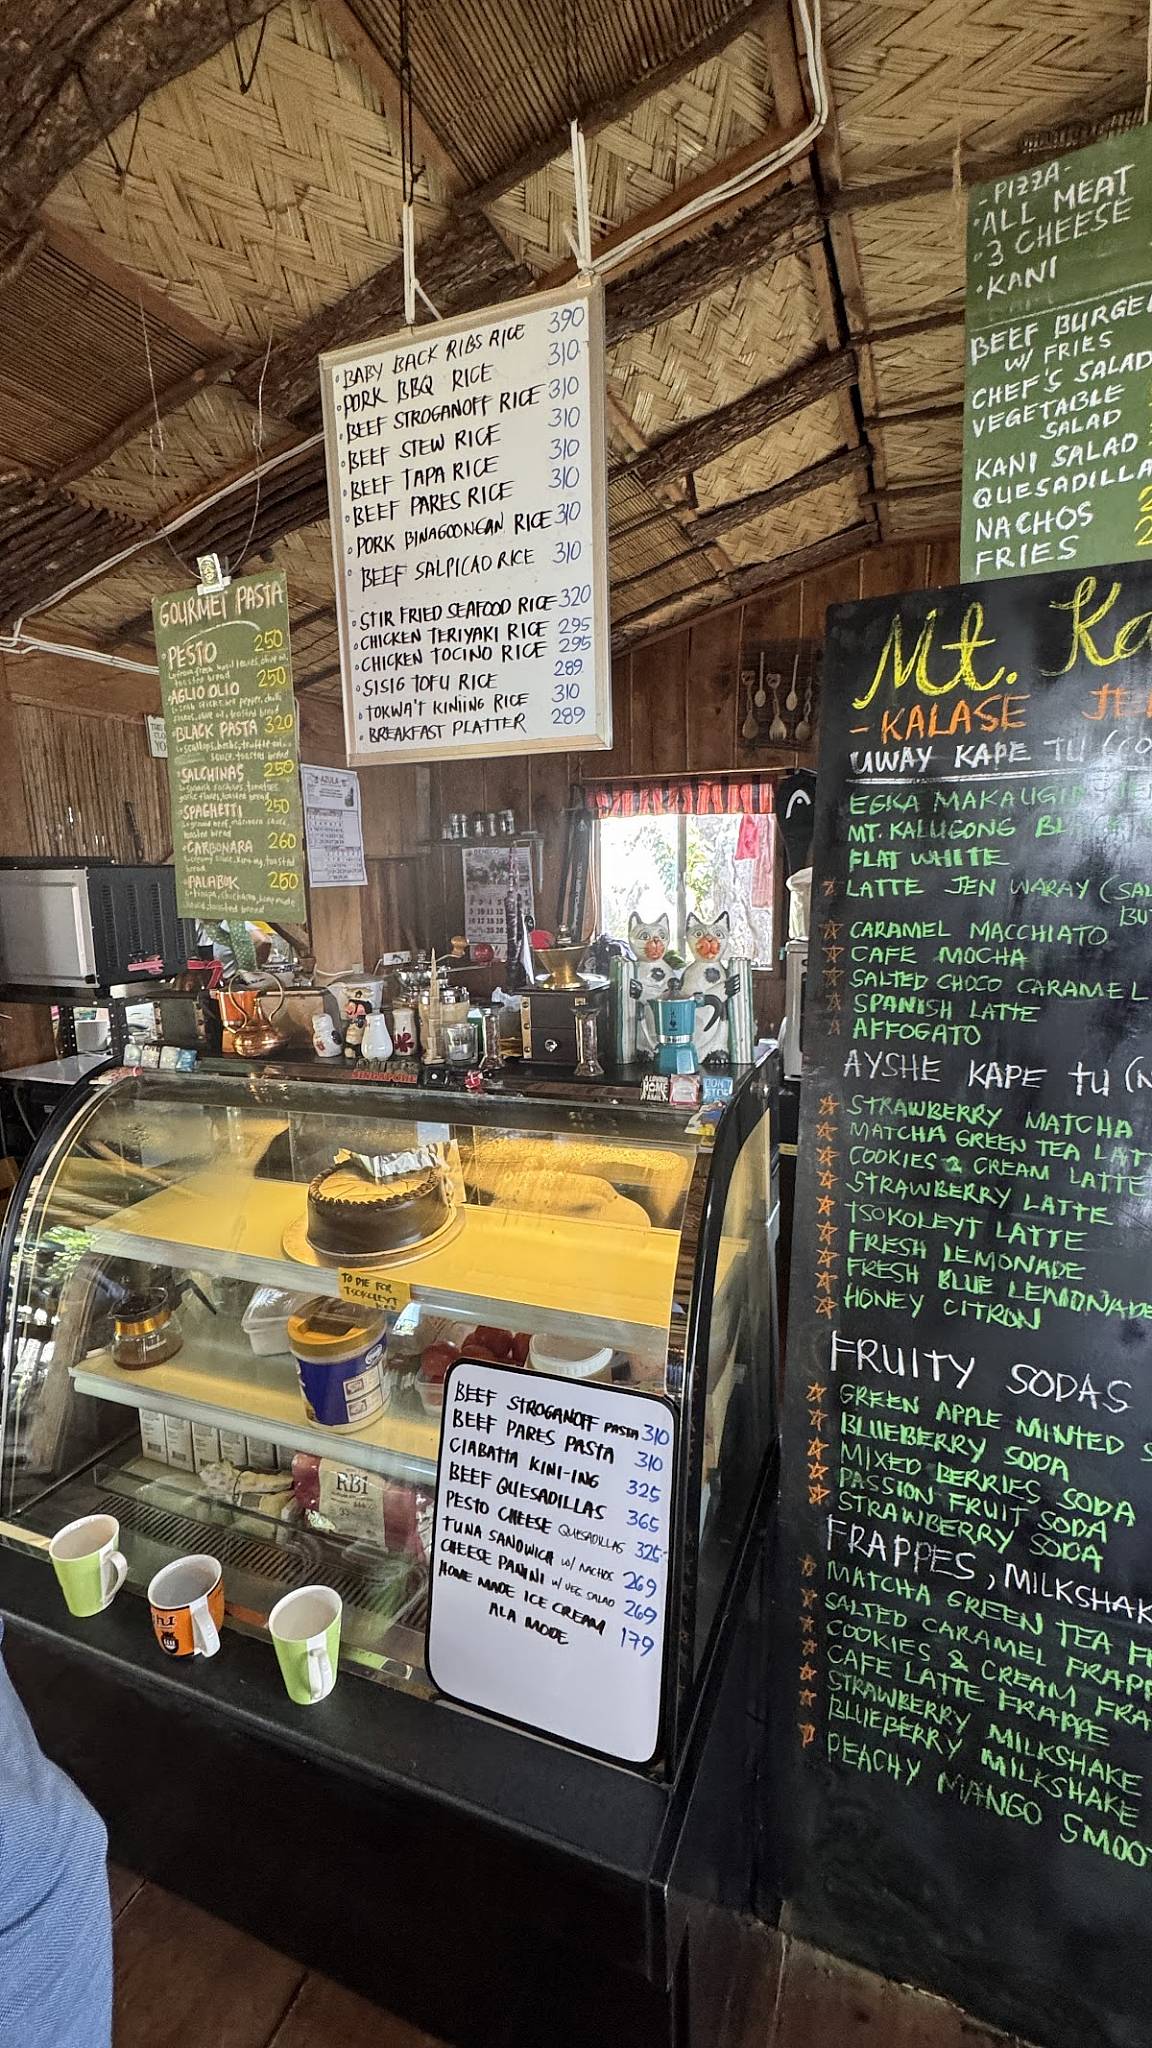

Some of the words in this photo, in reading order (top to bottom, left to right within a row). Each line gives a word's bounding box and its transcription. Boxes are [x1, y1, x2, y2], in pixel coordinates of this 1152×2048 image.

[982, 202, 1036, 236] ALL
[1054, 164, 1136, 213] MEAT
[987, 240, 1004, 267] 3
[1015, 197, 1134, 254] CHEESE
[986, 256, 1057, 300] KANI
[343, 363, 383, 390] BABY
[392, 344, 438, 374] BACK
[446, 333, 482, 362] RIBS
[489, 324, 525, 348] RICE
[547, 307, 584, 333] 390
[970, 322, 1038, 366] BEEF
[1044, 330, 1114, 364] FRIES
[344, 387, 388, 418] PORK
[397, 375, 434, 403] BBQ
[452, 363, 494, 392] RICE
[547, 340, 579, 366] 310
[973, 367, 1063, 410] CHEF'S
[973, 384, 1126, 438] VEGETABLE
[1040, 409, 1122, 440] SALAD
[975, 451, 1038, 481] KANI
[1051, 433, 1138, 468] SALAD
[975, 500, 1094, 542] NACHOS
[975, 535, 1079, 575] FRIES
[160, 591, 227, 627] GOURMET
[236, 581, 283, 614] PASTA
[360, 611, 393, 630] STIR
[400, 605, 442, 624] FRIED
[446, 599, 511, 619] SEAFOOD
[518, 595, 557, 614] RICE
[558, 585, 591, 608] 320
[168, 641, 217, 670] PESTO
[254, 630, 282, 651] 250
[361, 628, 422, 650] CHICKEN
[430, 625, 499, 645] TERIYAKI
[507, 620, 550, 639] RICE
[558, 617, 592, 634] 295
[851, 601, 1018, 710] Mt.
[171, 685, 204, 705] AGLIO
[209, 682, 239, 698] OLIO
[257, 666, 286, 688] 250
[176, 724, 214, 742] BLACK
[220, 720, 257, 739] PASTA
[264, 714, 292, 734] 320
[369, 724, 447, 743] BREAKFAST
[452, 713, 526, 737] PLATTER
[552, 707, 585, 725] 289
[181, 764, 244, 784] SALCHINAS
[263, 760, 294, 778] 250
[182, 804, 242, 820] SPAGHETTI
[265, 799, 289, 813] 250
[187, 840, 252, 853] CARBONARA
[267, 832, 296, 849] 260
[849, 850, 901, 872] FLAT
[912, 847, 1010, 867] WHITE
[187, 874, 240, 889] PALABOK
[850, 920, 951, 940] CARAMEL
[970, 921, 1108, 945] MACCHIATO
[851, 945, 917, 965] CAFE
[938, 947, 1030, 969] MOCHA
[850, 969, 928, 991] SALTED
[937, 974, 1002, 992] CHOCO
[1017, 978, 1149, 1001] CARAMEL
[853, 993, 952, 1020] SPANISH
[970, 1000, 1040, 1023] LATTE
[852, 1017, 981, 1046] AFFOGATO
[850, 1121, 947, 1144] MATCHA
[956, 1130, 1026, 1154] GREEN
[1036, 1139, 1080, 1161] TEA
[846, 1171, 1012, 1208] STRAWBERRY
[1023, 1194, 1114, 1226] LATTE
[342, 1272, 352, 1282] TO
[356, 1277, 369, 1287] DIE
[376, 1282, 392, 1293] FOR
[847, 1258, 918, 1285] FRESH
[938, 1269, 993, 1295] BLUE
[830, 1330, 975, 1389] FRUITY
[1006, 1364, 1133, 1413] SODAS
[455, 1381, 498, 1407] BEEF
[507, 1395, 600, 1432] STROGANOFF
[604, 1422, 639, 1440] PASTA
[641, 1424, 670, 1445] 310
[453, 1409, 498, 1433] BEEF
[506, 1419, 555, 1446] PARES
[564, 1435, 614, 1465] PASTA
[634, 1451, 663, 1471] 310
[449, 1462, 492, 1488] BEEF
[496, 1477, 607, 1520] QUESADILLAS
[627, 1510, 659, 1532] 365
[529, 1455, 599, 1488] KINI-ING
[626, 1480, 661, 1502] 325
[840, 1441, 921, 1475] MIXED
[936, 1462, 1041, 1504] BERRIES
[1056, 1487, 1136, 1527] SODA
[447, 1490, 489, 1515] PESTO
[498, 1507, 553, 1534] CHEESE
[558, 1524, 626, 1554] QUESADILLAS
[839, 1467, 934, 1505] PASSION
[949, 1492, 1030, 1527] FRUIT
[1037, 1511, 1107, 1544] SODA
[442, 1516, 482, 1538] TUNA
[579, 1564, 614, 1582] NACHOS
[623, 1571, 657, 1597] 269
[441, 1538, 493, 1565] CHEESE
[498, 1555, 545, 1585] PANINI
[587, 1591, 615, 1608] SALAD
[624, 1600, 657, 1625] 269
[477, 1576, 515, 1599] MADE
[524, 1591, 548, 1609] ICE
[552, 1602, 606, 1635] CREAM
[620, 1627, 654, 1657] 179
[489, 1602, 517, 1623] ALA
[525, 1616, 569, 1646] MODE
[827, 1560, 931, 1606] MATCHA
[947, 1591, 1043, 1635] GREEN
[1055, 1619, 1113, 1655] TEA
